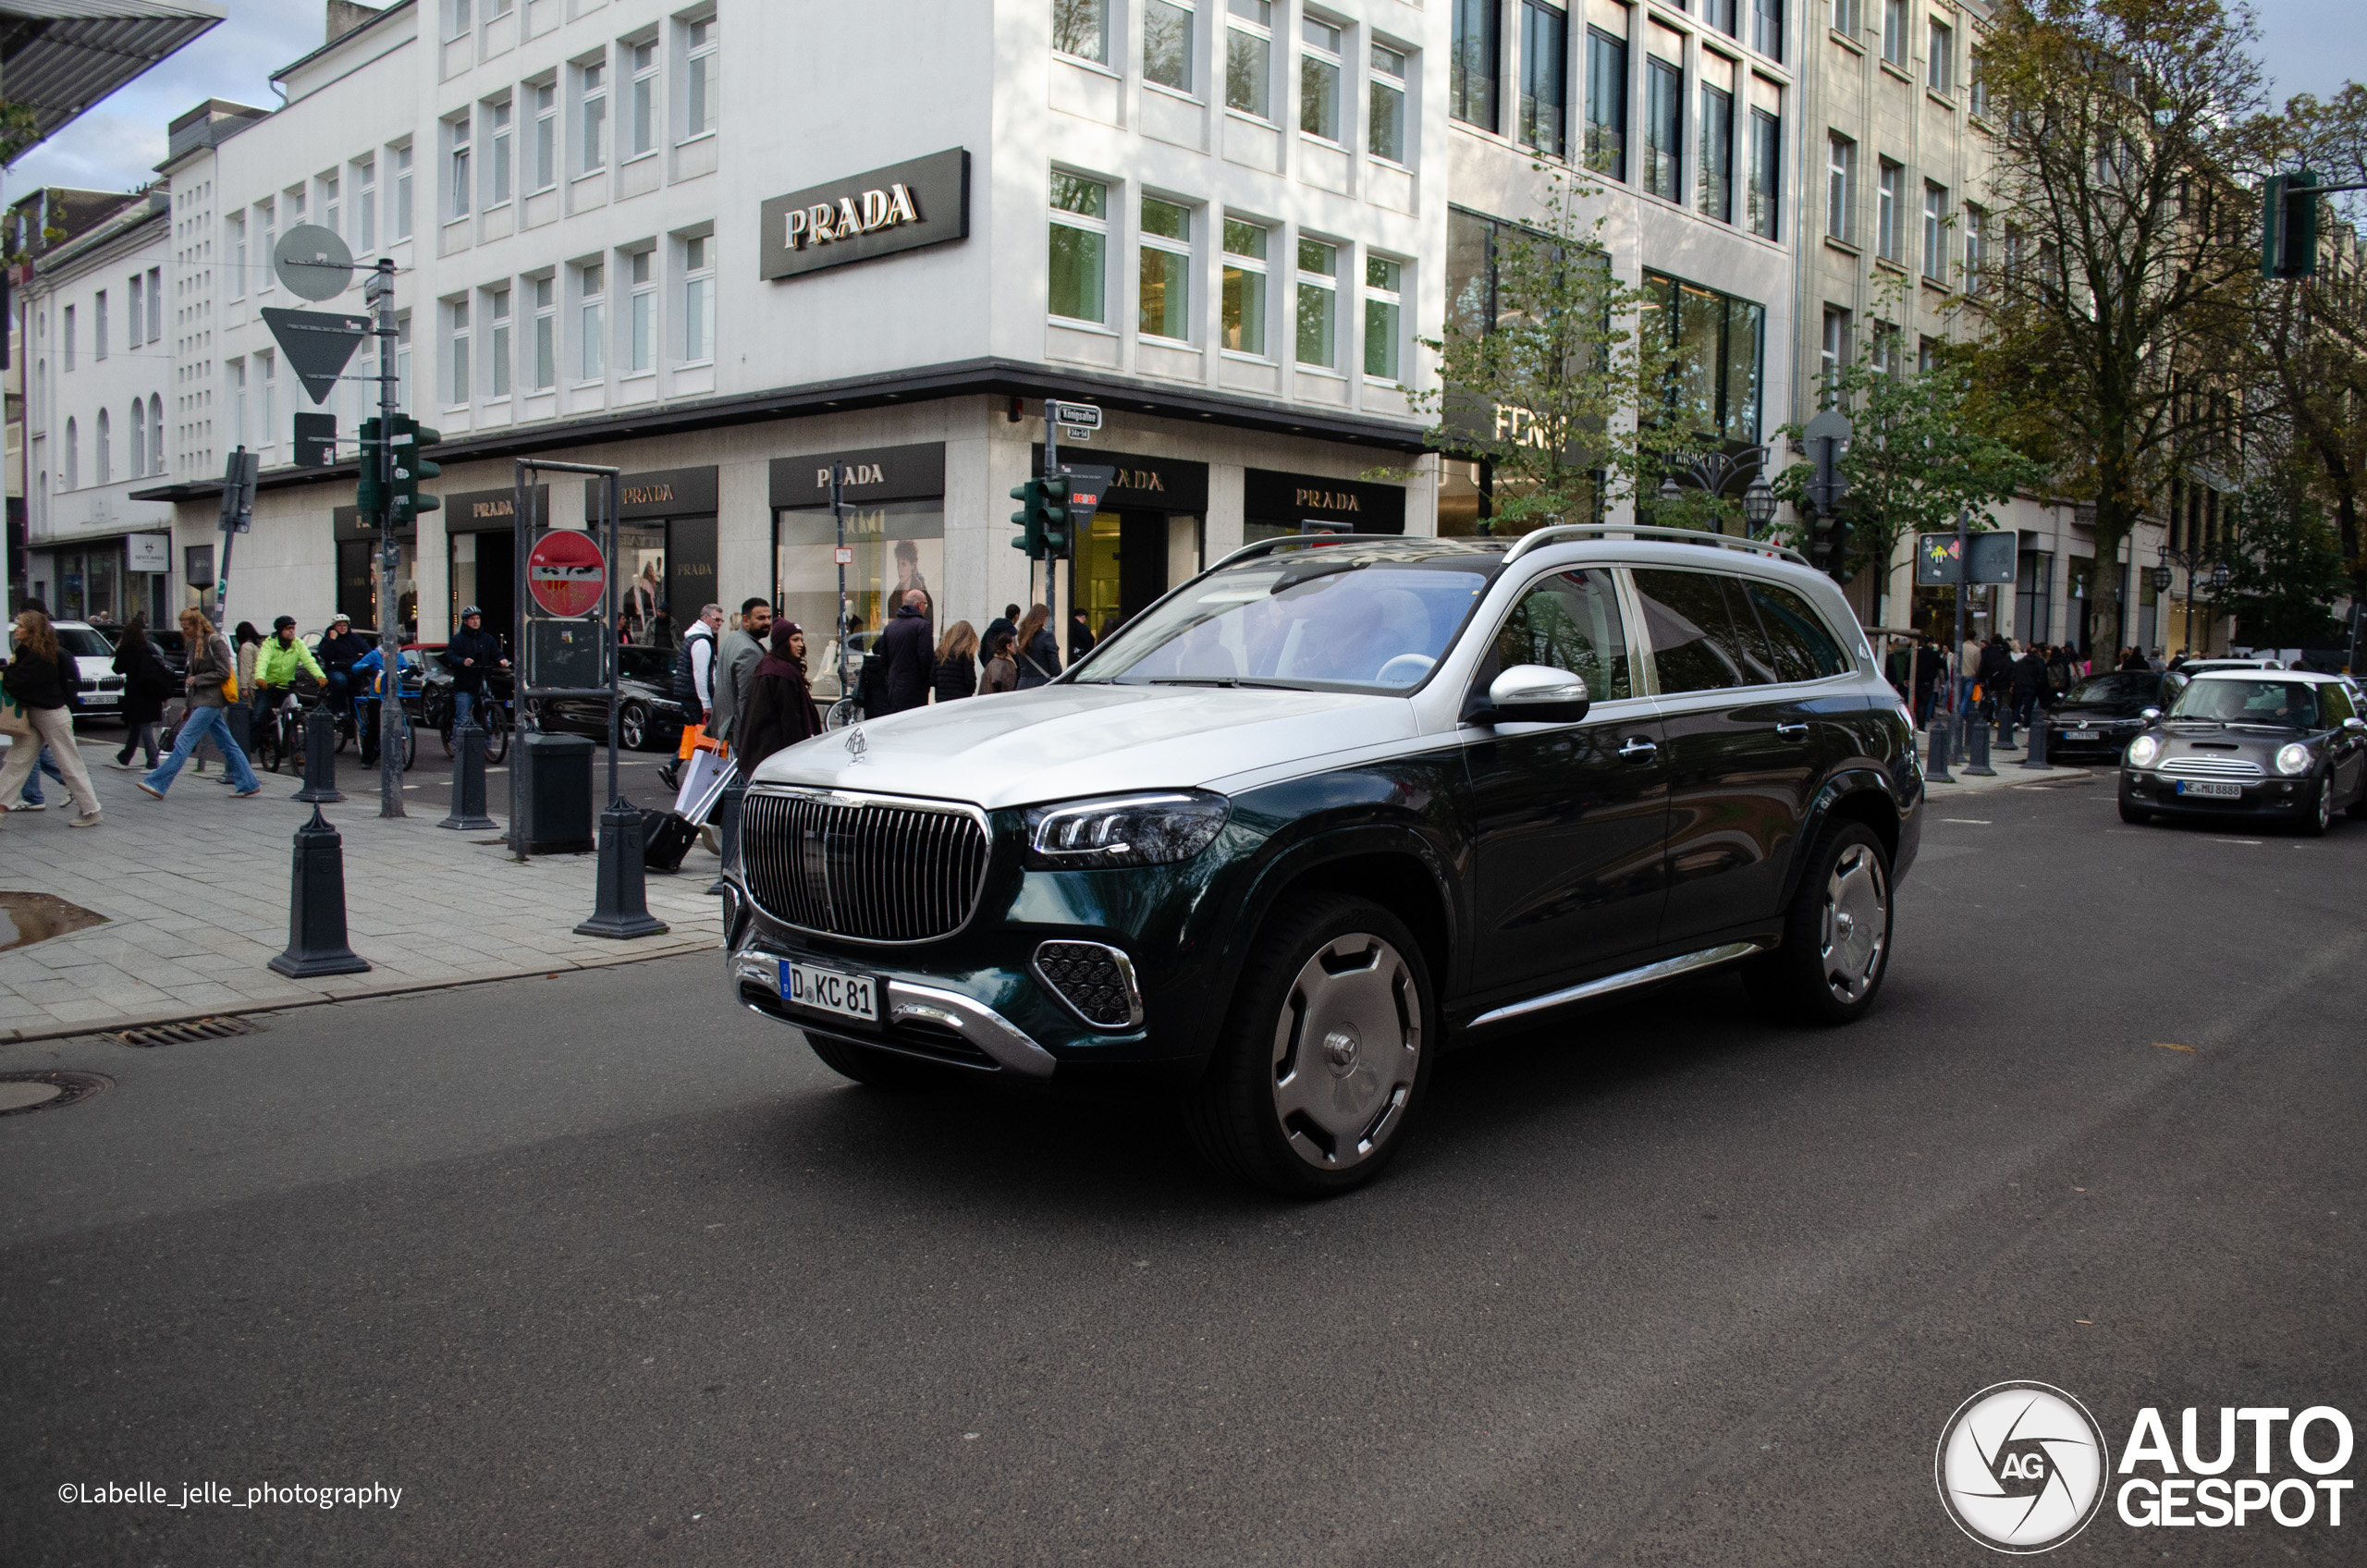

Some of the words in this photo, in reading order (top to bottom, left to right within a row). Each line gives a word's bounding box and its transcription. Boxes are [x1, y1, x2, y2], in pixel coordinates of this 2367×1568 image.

[785, 183, 918, 250] PRADA
[1063, 408, 1097, 423] Königsallee
[1675, 447, 1727, 471] MONCLR
[816, 463, 886, 488] PADA
[1109, 468, 1165, 492] ADA
[620, 484, 674, 505] PRADA
[1295, 487, 1362, 512] PRADA
[472, 499, 515, 518] PRADA
[677, 562, 713, 576] PRADA
[2183, 782, 2195, 793] NE
[2201, 783, 2214, 794] MU
[2215, 784, 2240, 796] 8888
[791, 968, 803, 998] D
[816, 974, 841, 1007] KC
[847, 980, 872, 1015] 81
